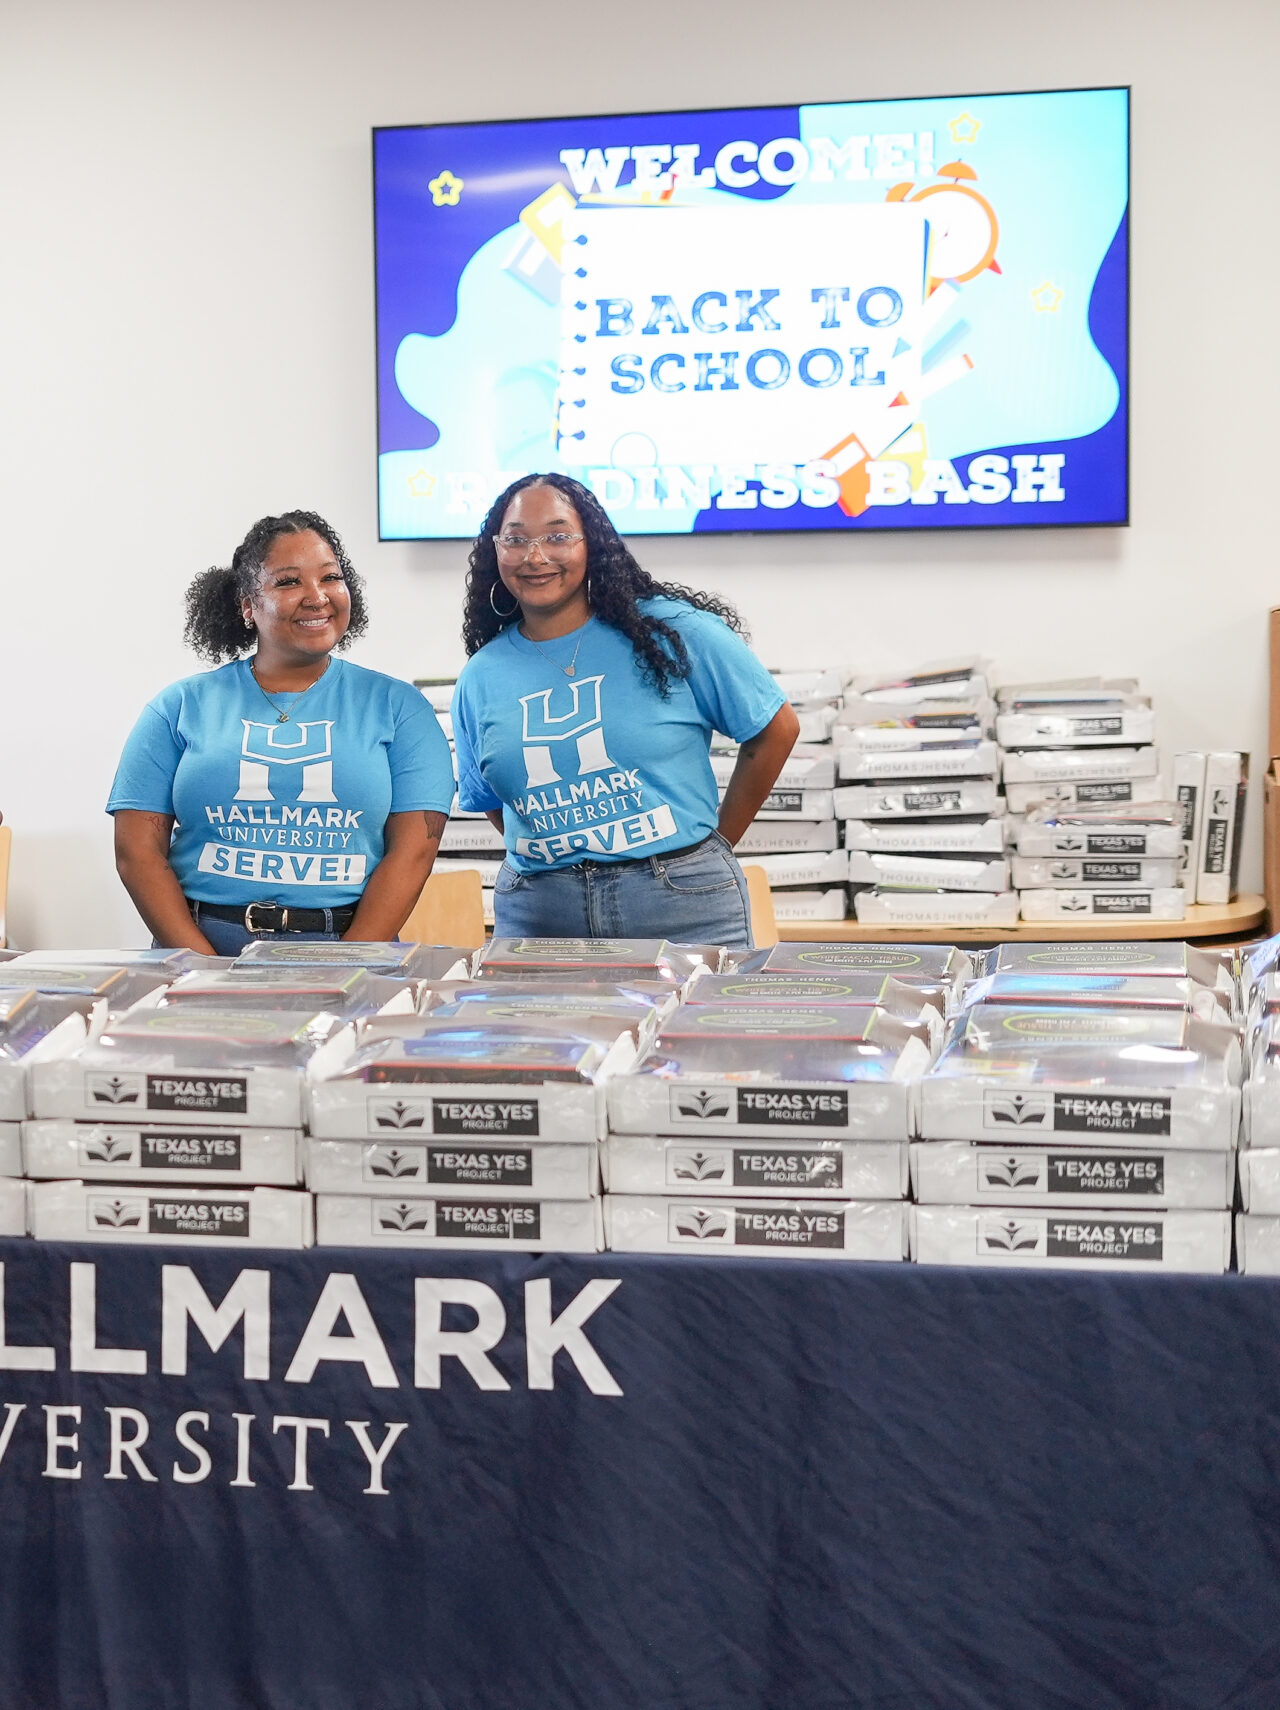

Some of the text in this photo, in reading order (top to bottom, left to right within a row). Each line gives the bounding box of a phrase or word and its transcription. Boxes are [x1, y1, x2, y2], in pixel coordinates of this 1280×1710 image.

[560, 131, 935, 195] WELCOME!
[596, 286, 903, 336] BACK TO
[611, 347, 886, 394] SCHOOL
[446, 453, 1066, 515] RDINESS BASH
[513, 768, 643, 816] HALLMARK
[205, 805, 363, 829] HALLMARK
[218, 826, 352, 848] UNIVERSITY
[454, 838, 492, 847] HENRY
[1090, 836, 1145, 847] TEXAS YES
[212, 848, 352, 882] SERVE!
[1085, 864, 1140, 875] TEXAS YES
[1095, 895, 1150, 907] TEXAS YES
[152, 1080, 243, 1098] TEXAS YES
[174, 1096, 218, 1107] PROJECT
[743, 1093, 843, 1111] TEXAS YES
[1060, 1099, 1164, 1120] TEXAS YES
[438, 1103, 534, 1121] TEXAS YES
[768, 1109, 816, 1121] PROJECT
[462, 1119, 509, 1130] PROJECT
[1086, 1117, 1137, 1129] PROJECT
[145, 1138, 236, 1156] TEXAS YES
[168, 1154, 212, 1165] PROJECT
[432, 1153, 527, 1171] TEXAS YES
[739, 1155, 799, 1172] TEXAS
[456, 1169, 502, 1180] PROJECT
[763, 1171, 811, 1183] PROJECT
[1054, 1160, 1157, 1179] TEXAS YES
[1080, 1177, 1130, 1189] PROJECT
[154, 1204, 244, 1222] TEXAS YES
[441, 1206, 535, 1225] TEXAS YES
[177, 1220, 221, 1231] PROJECT
[465, 1222, 510, 1233] PROJECT
[742, 1214, 839, 1233] TEXAS YES
[765, 1230, 813, 1241] PROJECT
[1053, 1224, 1156, 1245] TEXAS YES
[1078, 1241, 1129, 1253] PROJECT
